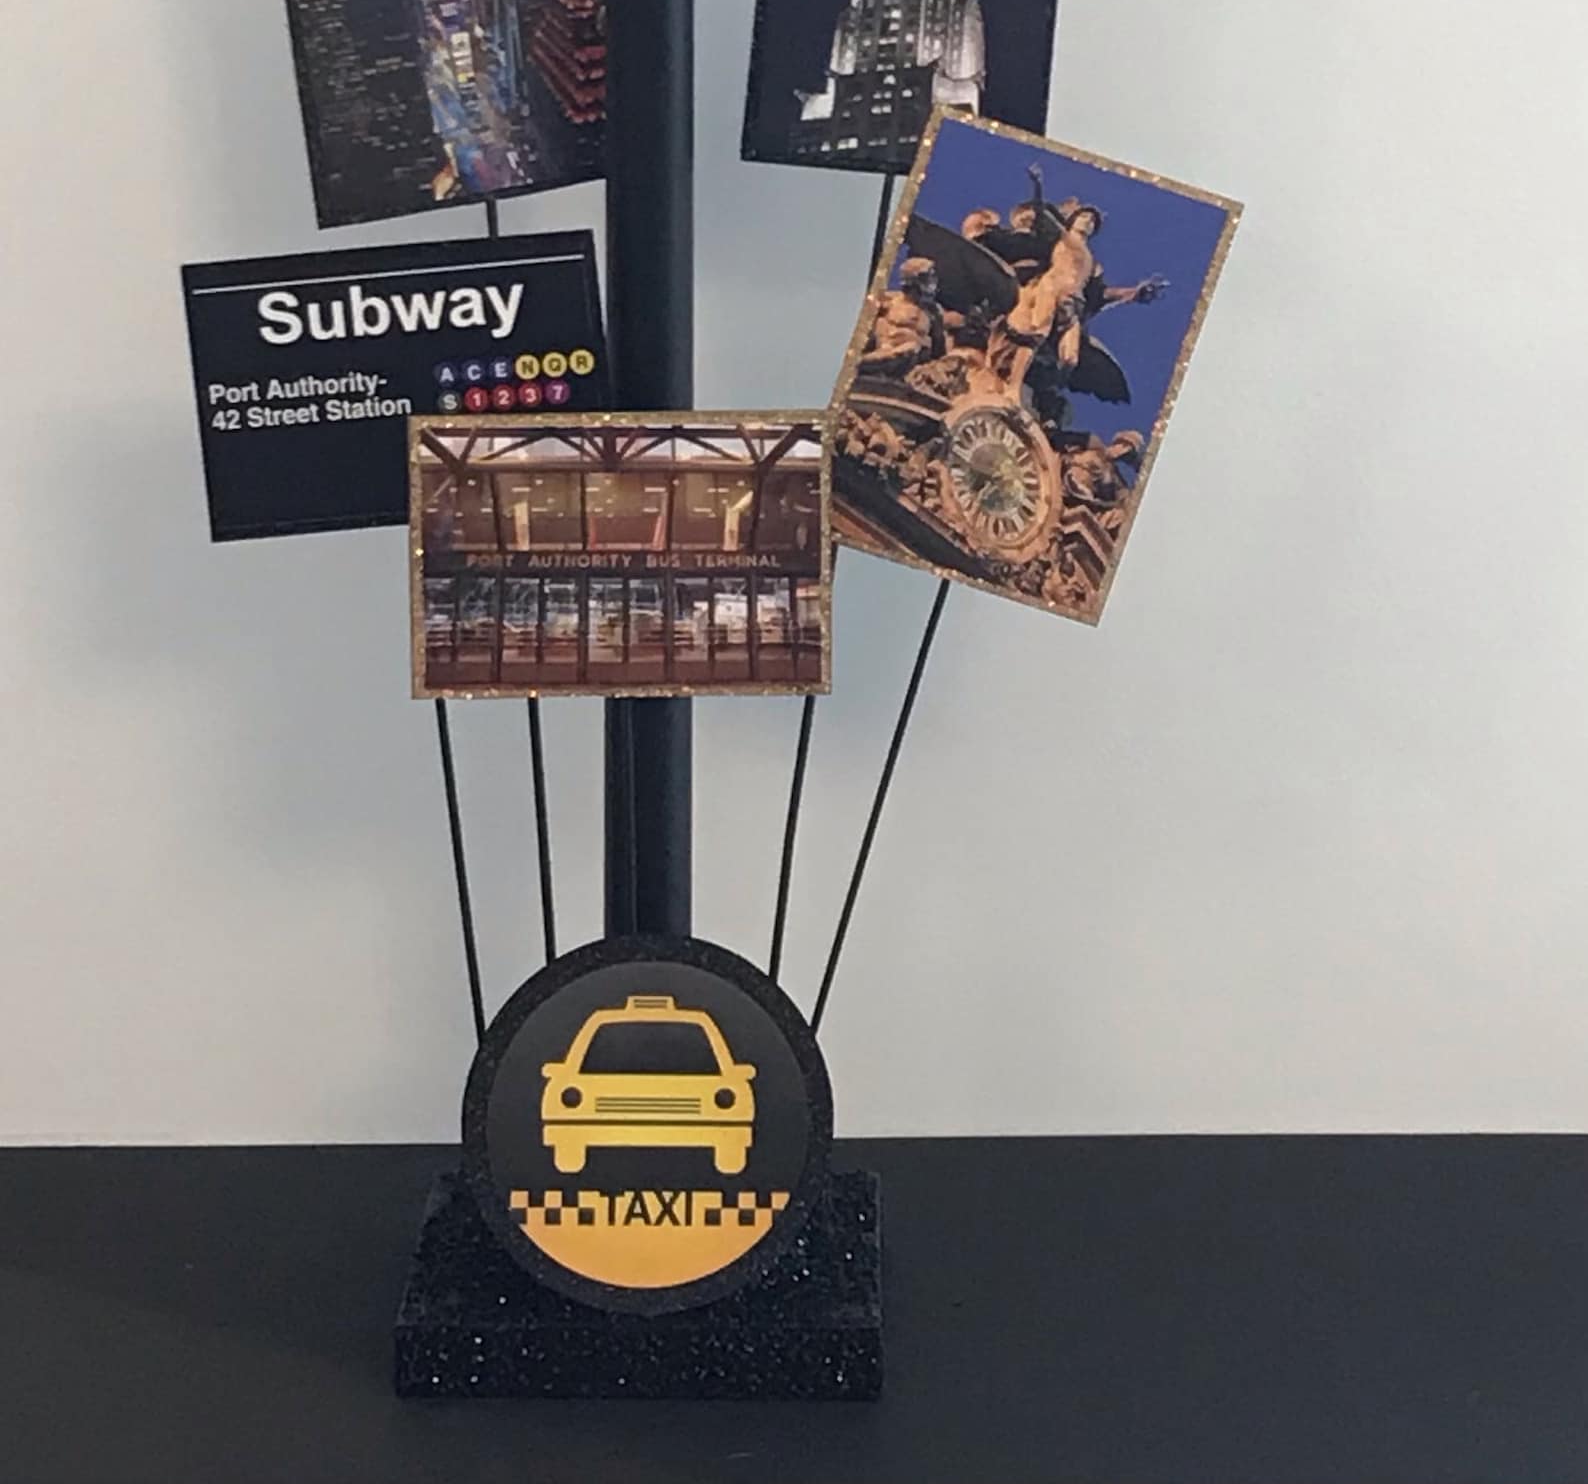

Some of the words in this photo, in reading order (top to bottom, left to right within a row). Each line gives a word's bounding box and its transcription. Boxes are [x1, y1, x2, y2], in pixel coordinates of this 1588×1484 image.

[258, 283, 524, 346] Subway
[209, 382, 260, 405] Port
[266, 371, 388, 402] Authority-
[211, 409, 242, 431] 42
[247, 402, 321, 429] Street
[326, 396, 411, 423] Station
[466, 554, 514, 569] PORT
[528, 554, 633, 569] AUTHORITY
[645, 553, 682, 569] BUS
[695, 553, 782, 569] TERMINAL
[599, 1191, 693, 1227] TAXI
